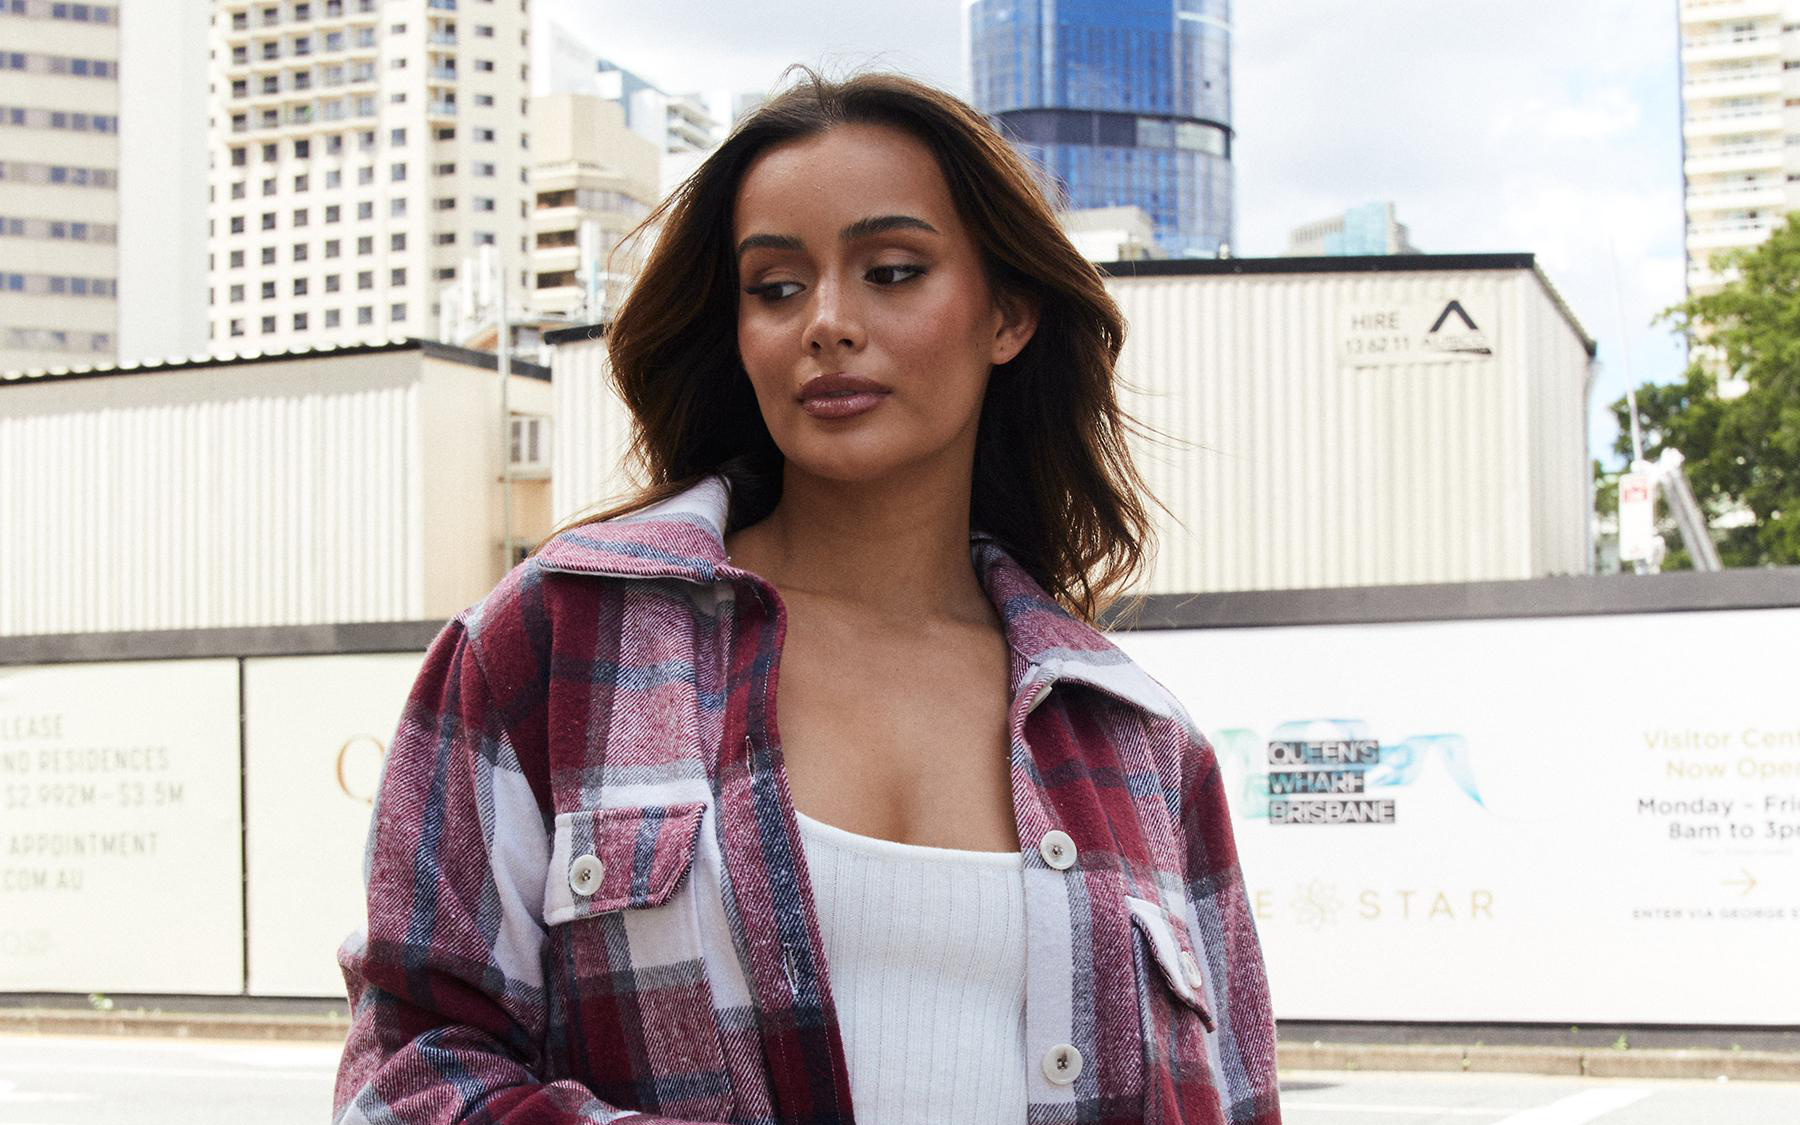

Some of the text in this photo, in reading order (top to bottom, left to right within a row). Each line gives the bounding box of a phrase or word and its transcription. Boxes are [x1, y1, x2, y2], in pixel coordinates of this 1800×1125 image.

[1351, 312, 1400, 330] HIRE
[1, 716, 63, 740] LEASE
[1643, 729, 1731, 750] Visitor
[38, 746, 170, 772] RESIDENCES
[1665, 760, 1726, 780] Now
[1269, 770, 1364, 793] WHARF
[1269, 800, 1395, 823] BRISBANE
[1638, 798, 1733, 818] Monday
[1669, 820, 1800, 841] 8am to 3p
[9, 832, 158, 856] APPOINTMENT
[1359, 890, 1494, 919] STAR
[1633, 908, 1682, 920] ENTER
